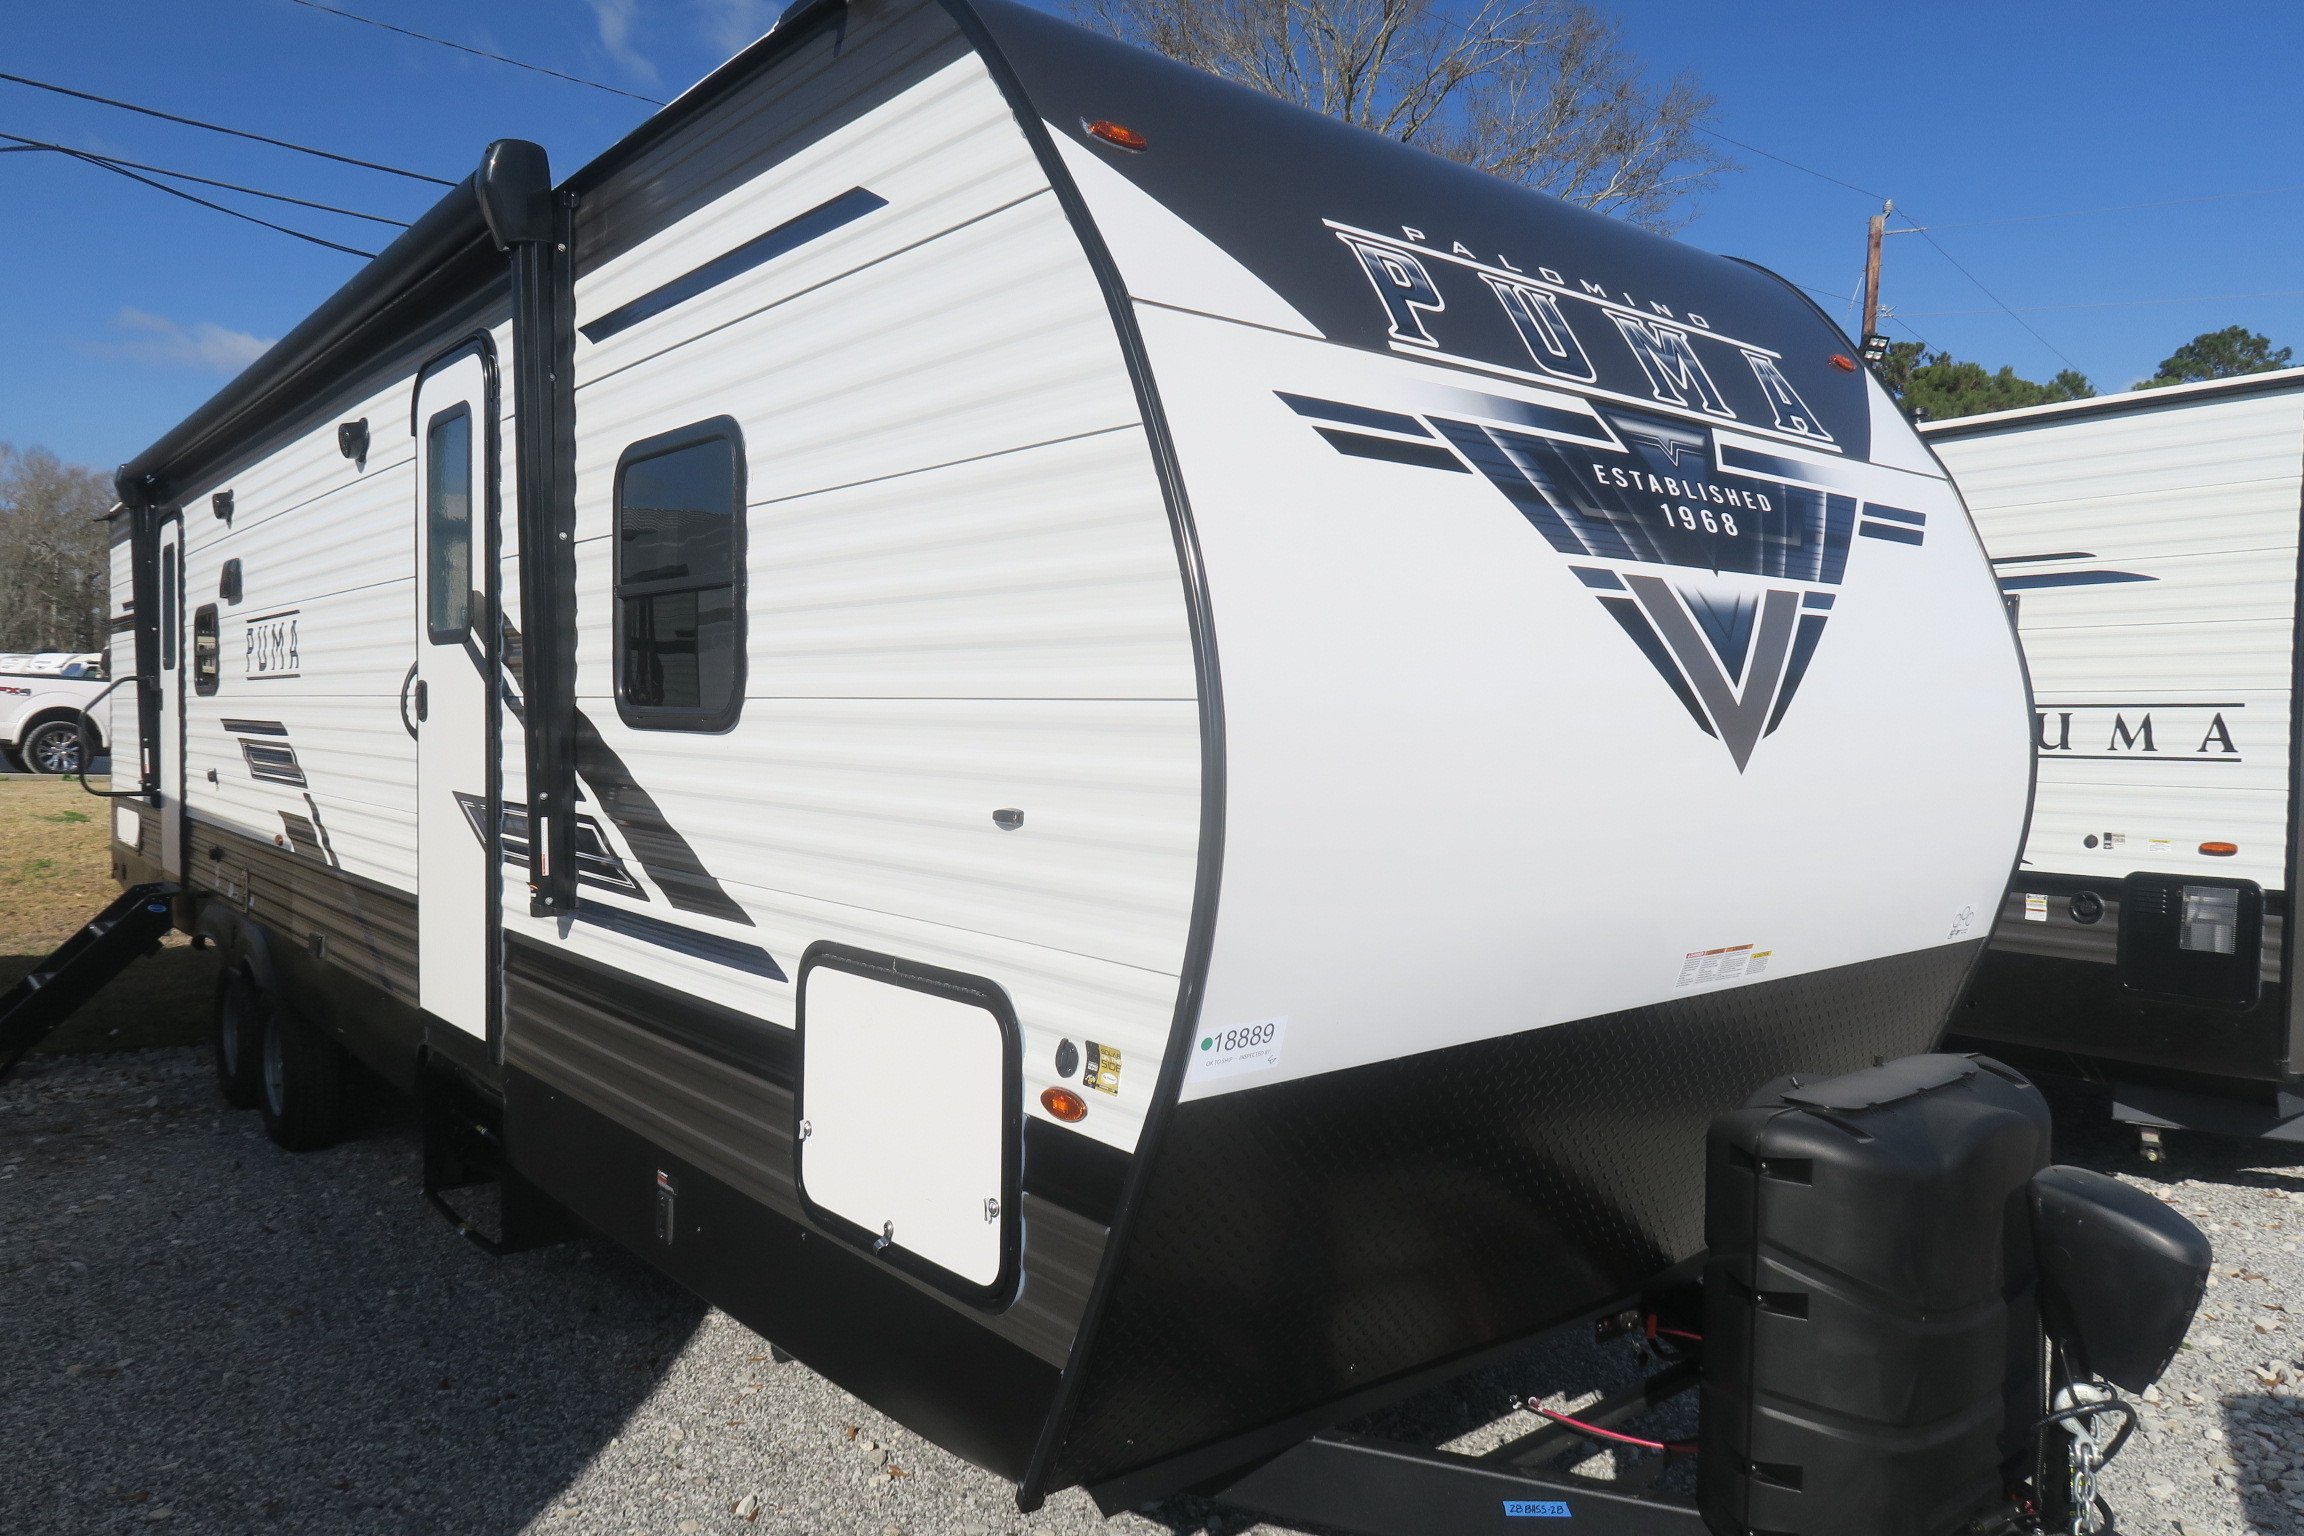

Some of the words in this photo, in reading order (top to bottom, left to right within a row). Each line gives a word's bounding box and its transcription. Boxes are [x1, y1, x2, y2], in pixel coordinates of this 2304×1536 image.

[1402, 225, 1710, 329] PALOMINO
[1336, 231, 1834, 443] PUMA
[1593, 464, 1772, 512] ESTABLISHED
[1660, 503, 1738, 537] 1968
[245, 620, 299, 672] PUMA
[1214, 1023, 1275, 1053] 18889
[1101, 1060, 1121, 1073] SIDE
